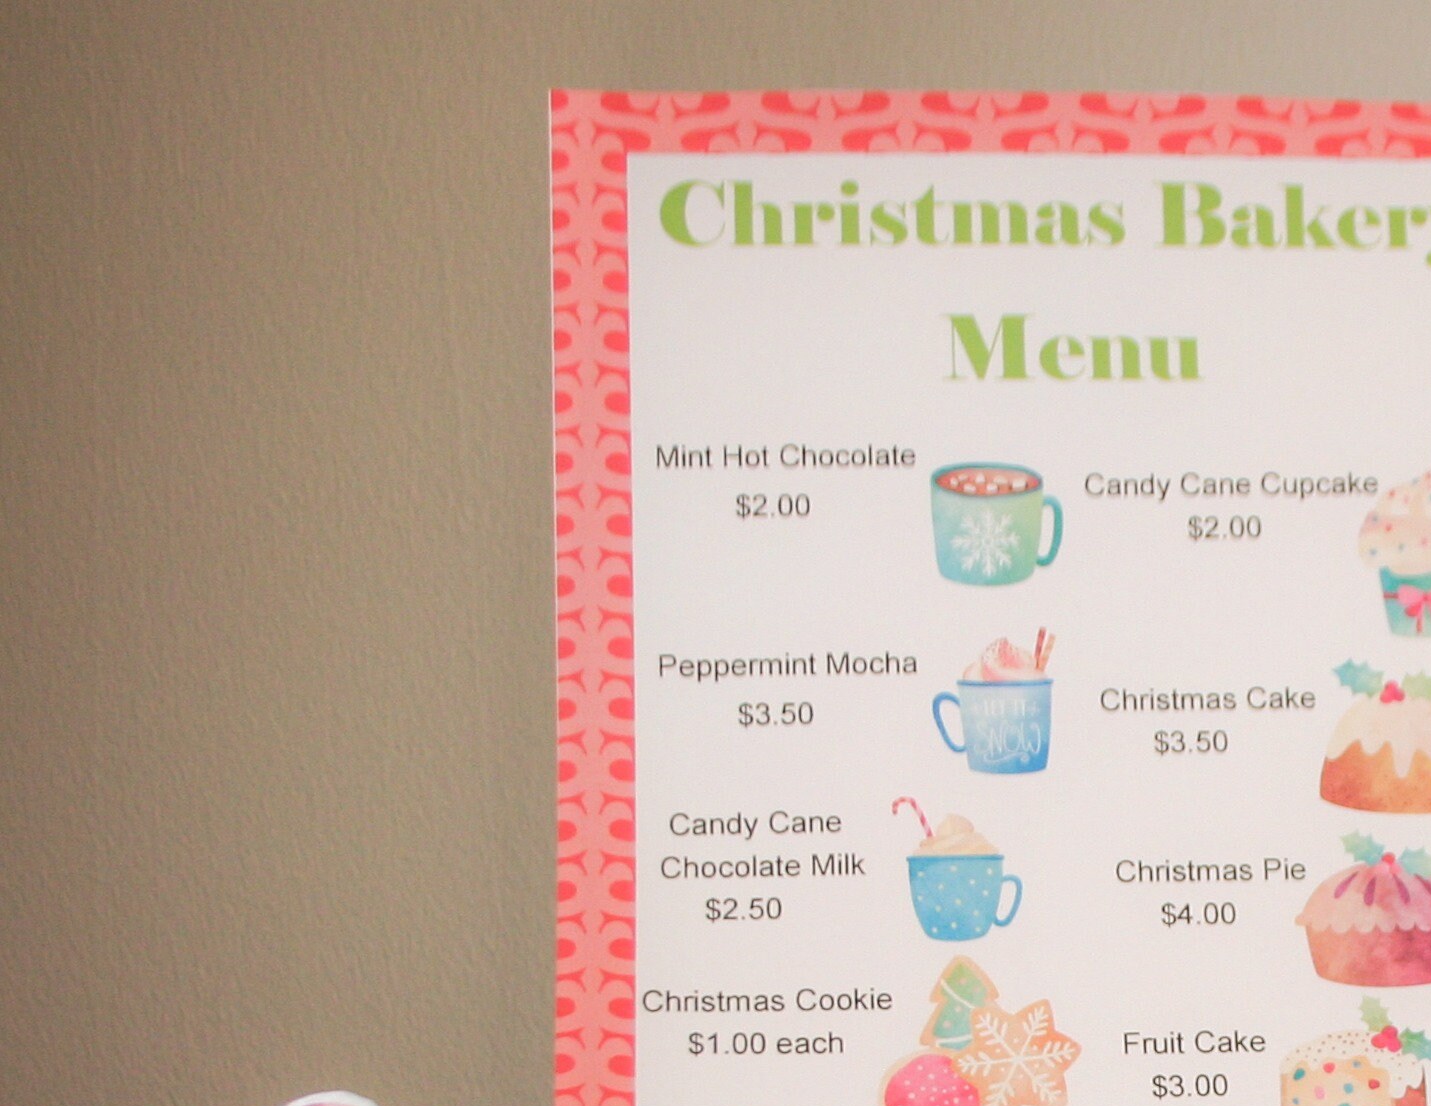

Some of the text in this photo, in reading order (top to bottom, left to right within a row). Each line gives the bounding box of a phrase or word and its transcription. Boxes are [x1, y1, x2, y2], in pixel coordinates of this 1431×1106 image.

[660, 181, 1125, 247] Christmas
[949, 315, 1199, 381] Menu
[657, 444, 915, 468] Mint Hot Chocolate
[1085, 472, 1378, 505] Candy Cane Cupcake
[736, 494, 810, 519] $2.00
[1188, 516, 1261, 541] $2.00
[659, 652, 917, 683] Peppermint Mocha
[1100, 687, 1315, 713] Christmas Cake
[739, 702, 814, 728] $3.50
[1154, 730, 1228, 756] $3.50
[669, 811, 841, 840] Candy Cane
[661, 853, 865, 879] Chocolate Milk
[1116, 858, 1306, 883] Christmas Pie
[706, 897, 782, 923] $2.50
[1161, 902, 1236, 928] $4.00
[642, 988, 892, 1013] Christmas Cookie
[688, 1032, 843, 1056] $1.00 each
[1124, 1030, 1265, 1054] Fruit Cake
[1152, 1074, 1228, 1099] $3.00
